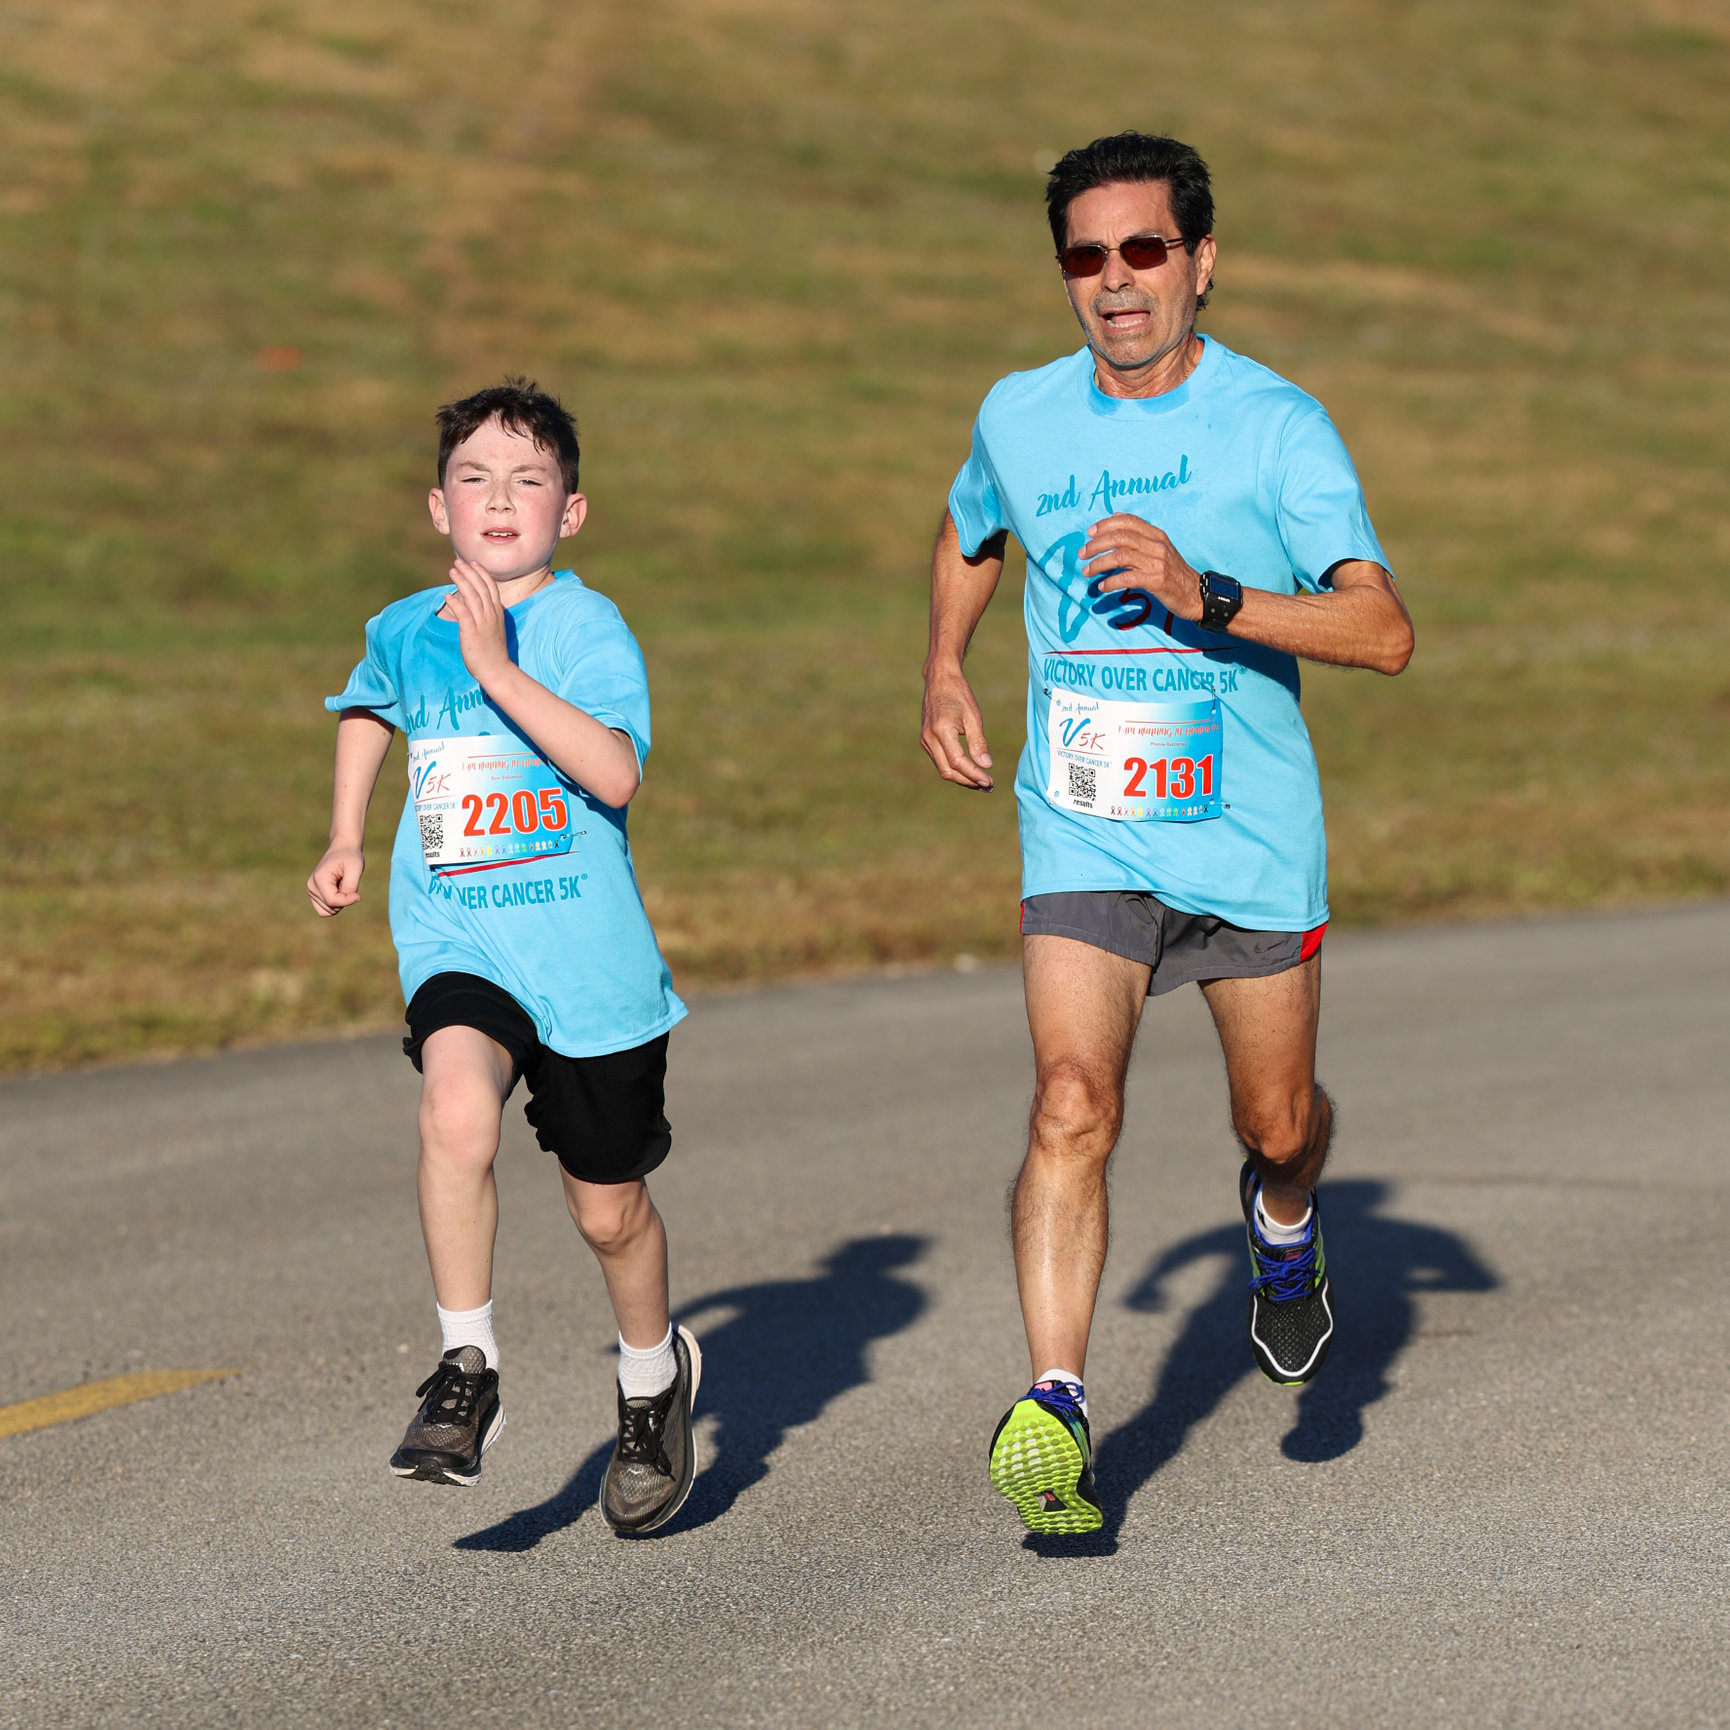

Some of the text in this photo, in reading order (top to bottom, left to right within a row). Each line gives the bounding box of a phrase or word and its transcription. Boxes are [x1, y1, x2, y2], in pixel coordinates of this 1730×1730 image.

[1035, 454, 1192, 517] 2nd Annual
[1043, 658, 1096, 687] VICTORY
[1101, 666, 1148, 691] OVER
[1152, 668, 1216, 693] CANCER
[1123, 754, 1214, 799] 2131
[461, 788, 569, 838] 2205
[1072, 798, 1094, 809] results
[456, 886, 489, 910] VER
[492, 879, 556, 908] CANCER
